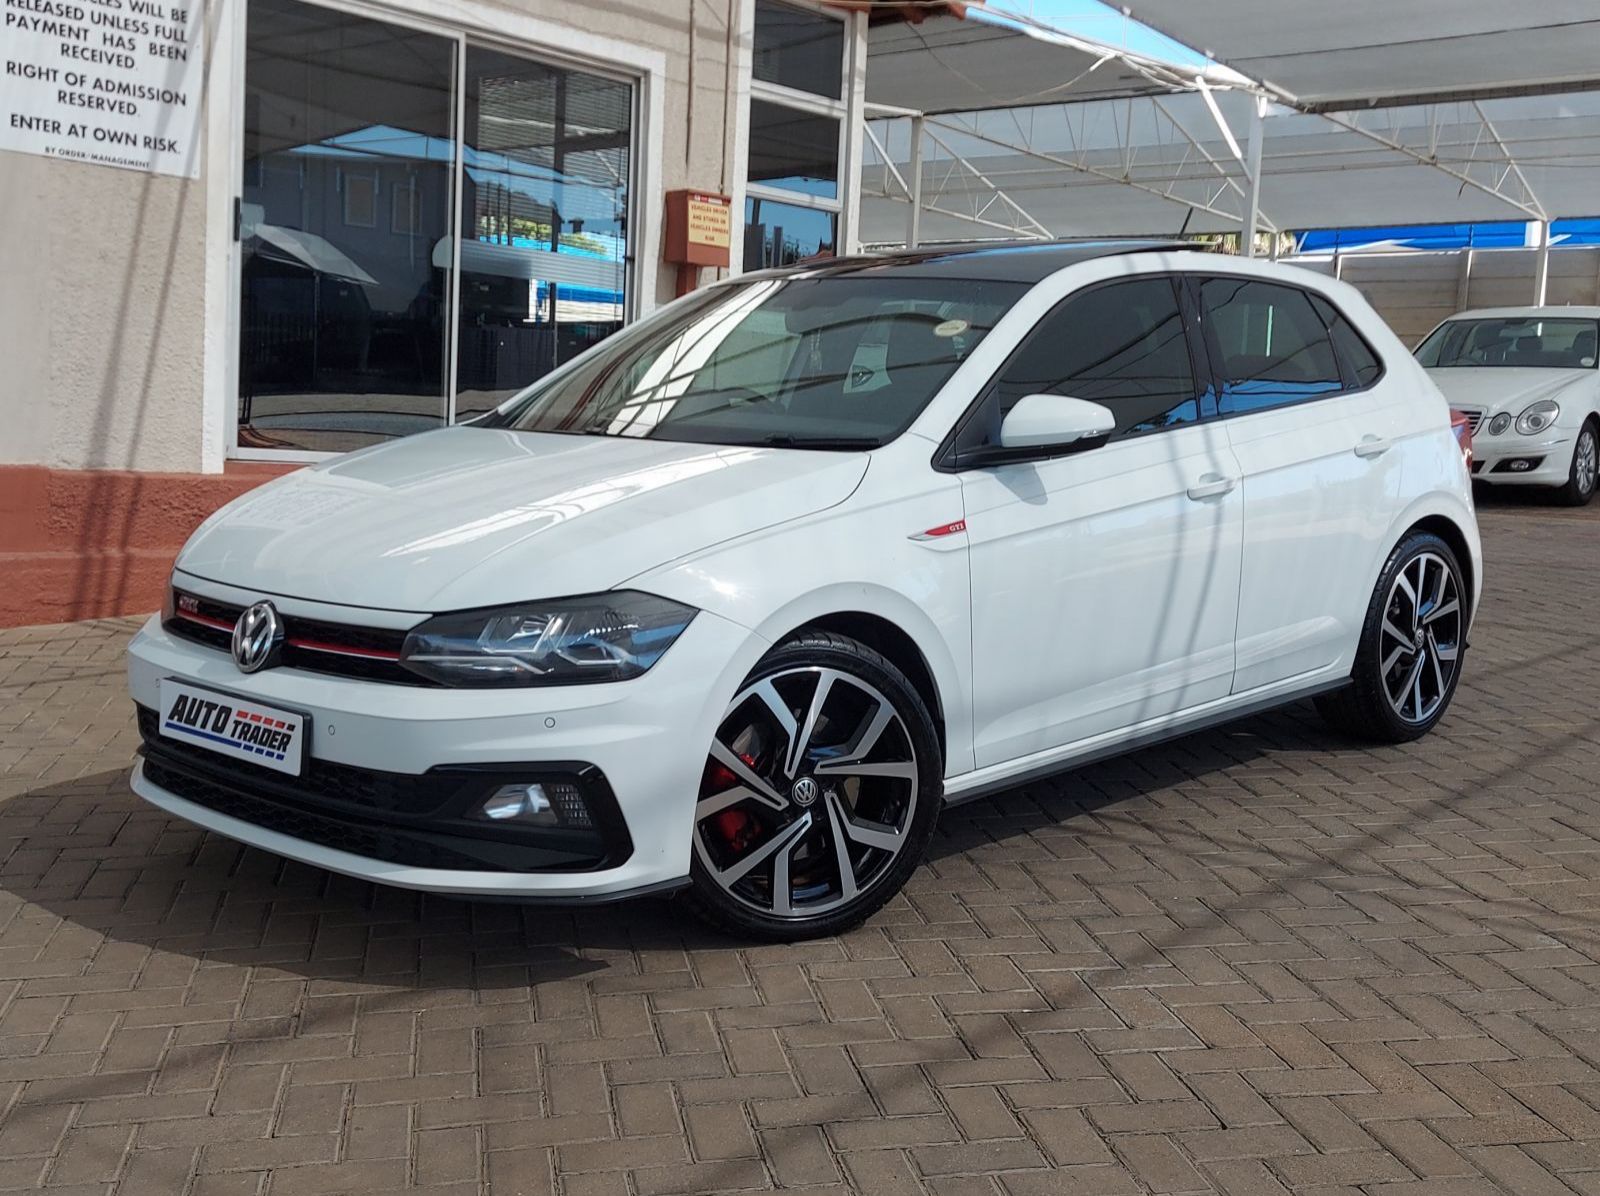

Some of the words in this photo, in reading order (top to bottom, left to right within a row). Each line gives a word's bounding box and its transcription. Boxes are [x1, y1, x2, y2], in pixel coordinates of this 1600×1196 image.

[90, 11, 149, 35] UNLESS
[154, 24, 188, 43] FULL
[130, 0, 165, 18] WILL
[171, 9, 188, 24] BE
[6, 13, 90, 42] PAYMENT
[103, 32, 137, 52] HAS
[149, 43, 188, 62] BEEN
[6, 61, 59, 83] RIGHT
[65, 72, 87, 87] OF
[92, 77, 187, 106] ADMISSION
[10, 113, 62, 136] ENTER
[67, 123, 88, 138] AT
[93, 127, 138, 147] OWN
[44, 146, 56, 154] BY
[949, 522, 965, 532] GTI
[168, 694, 233, 735] AUTO
[230, 720, 292, 753] TRADER
